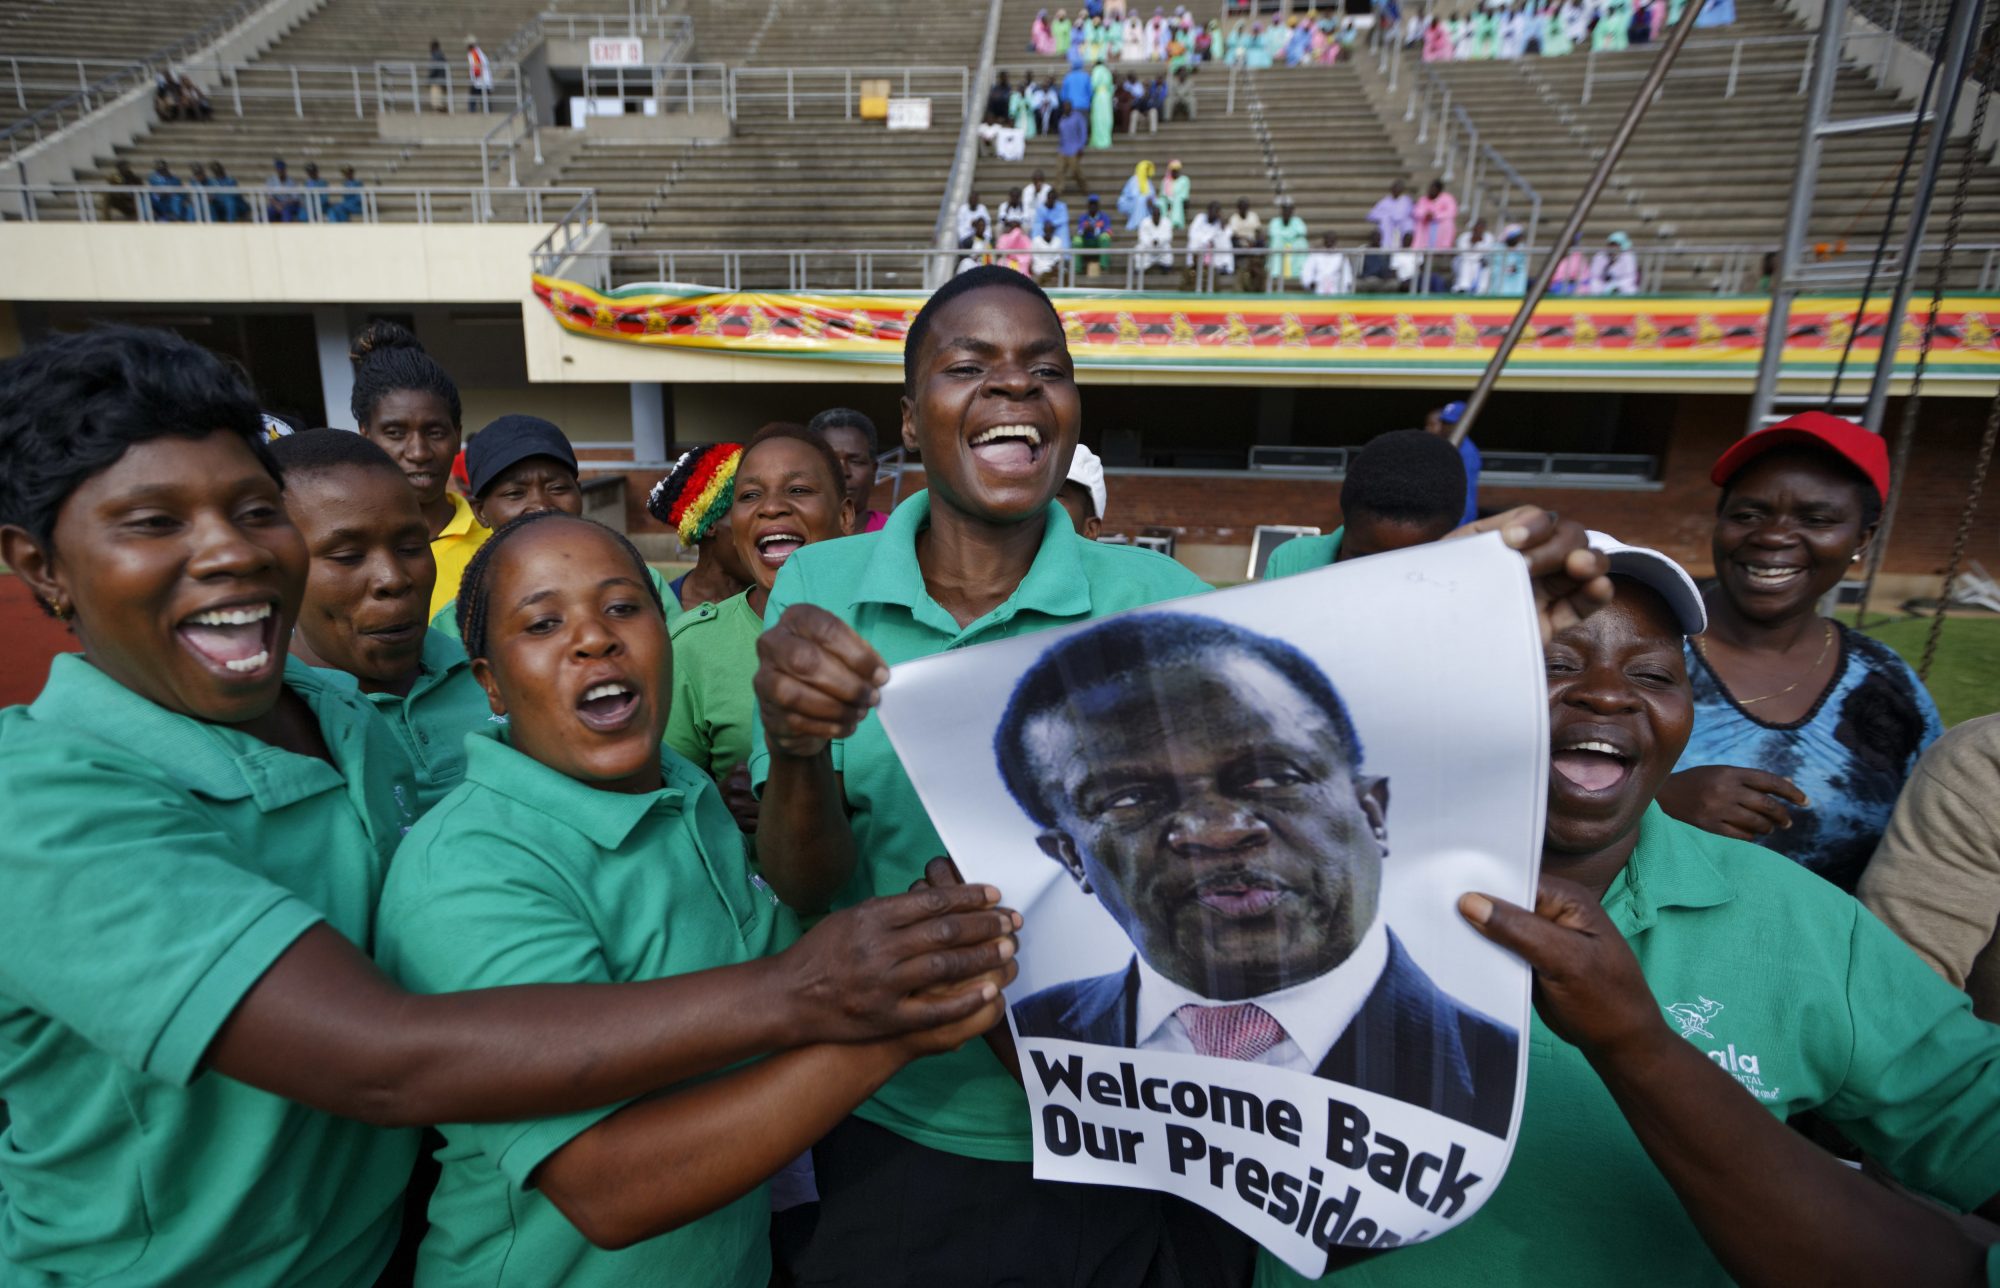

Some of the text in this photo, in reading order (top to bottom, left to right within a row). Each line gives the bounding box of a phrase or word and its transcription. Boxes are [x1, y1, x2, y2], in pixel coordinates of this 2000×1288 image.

[1028, 1049, 1483, 1220] Welcome Back
[1707, 1044, 1760, 1075] ala
[1042, 1103, 1432, 1254] Our Presiden
